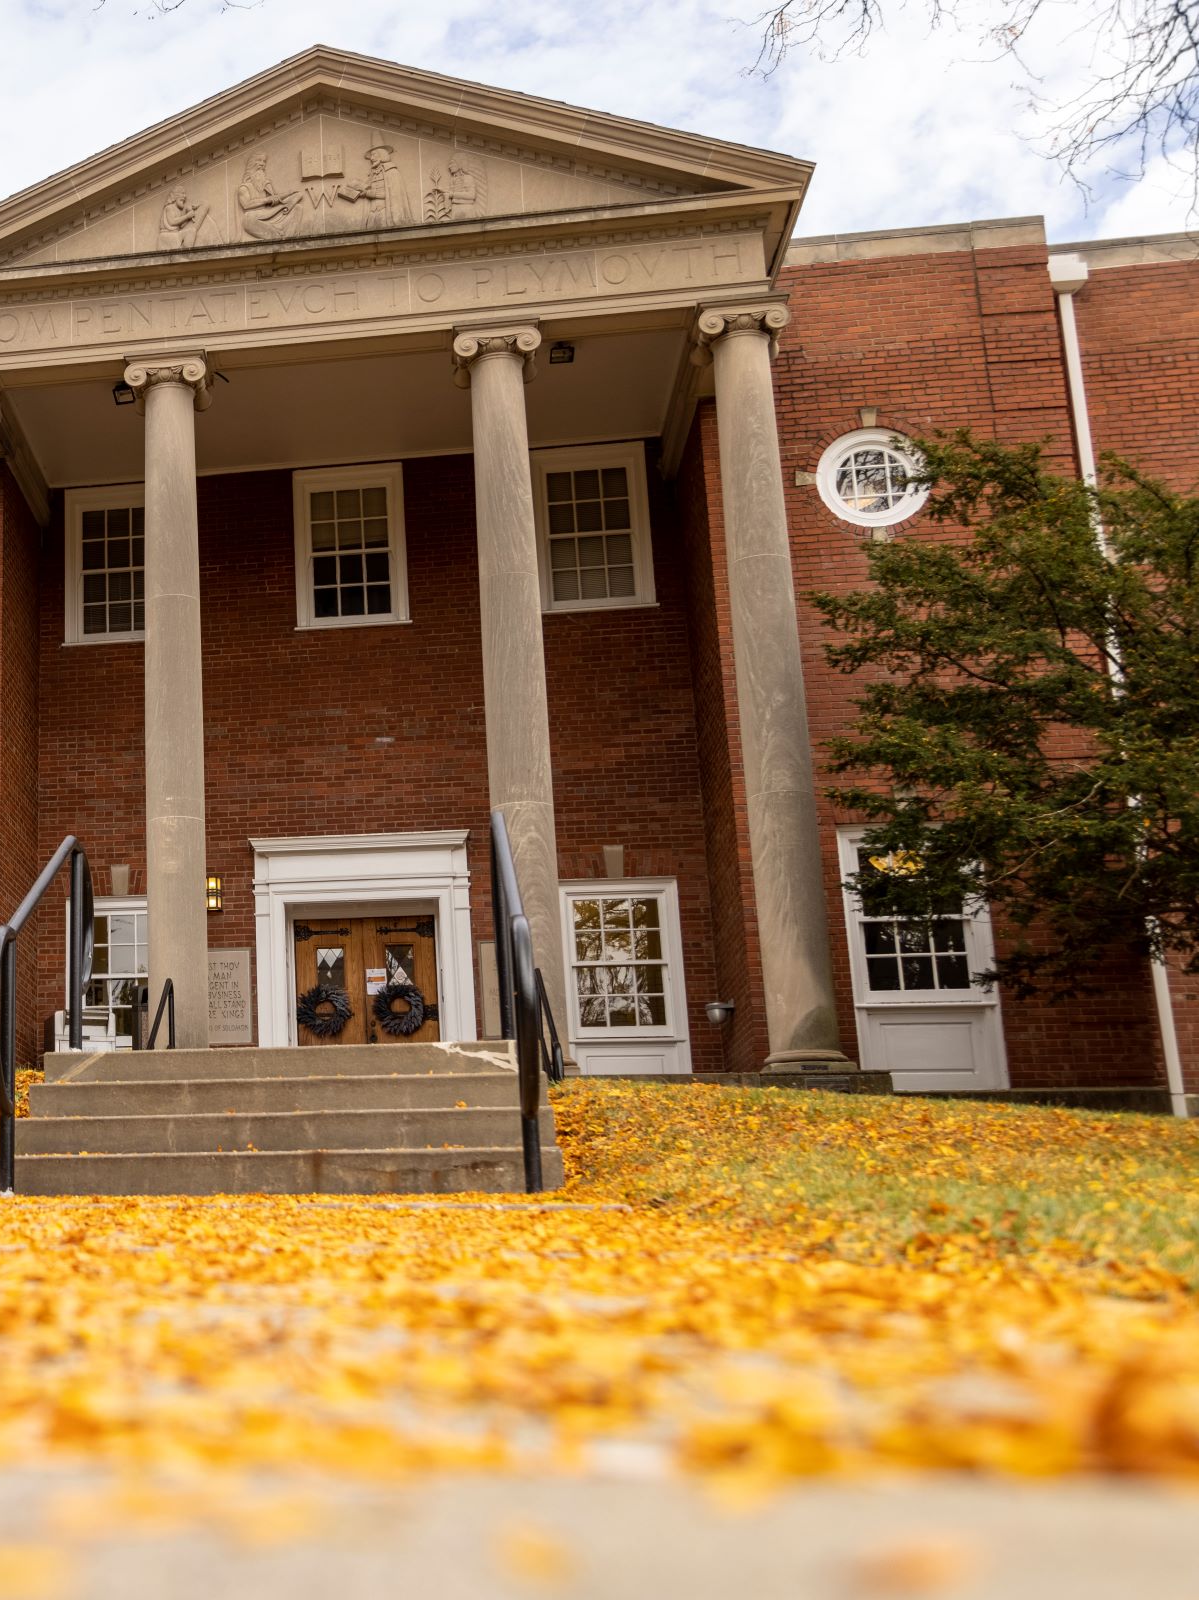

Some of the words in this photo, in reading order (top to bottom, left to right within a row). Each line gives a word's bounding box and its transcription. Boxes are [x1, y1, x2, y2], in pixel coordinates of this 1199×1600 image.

[73, 279, 360, 337] PENTATEVCH
[377, 271, 447, 309] TO
[472, 241, 745, 300] PLYMOVTH
[208, 961, 217, 971] ST
[213, 971, 232, 980] MAN
[208, 981, 228, 990] GENT
[231, 981, 239, 990] IN
[208, 1000, 222, 1009] ALL
[223, 1000, 246, 1009] STAND
[221, 1009, 245, 1019] KINGS
